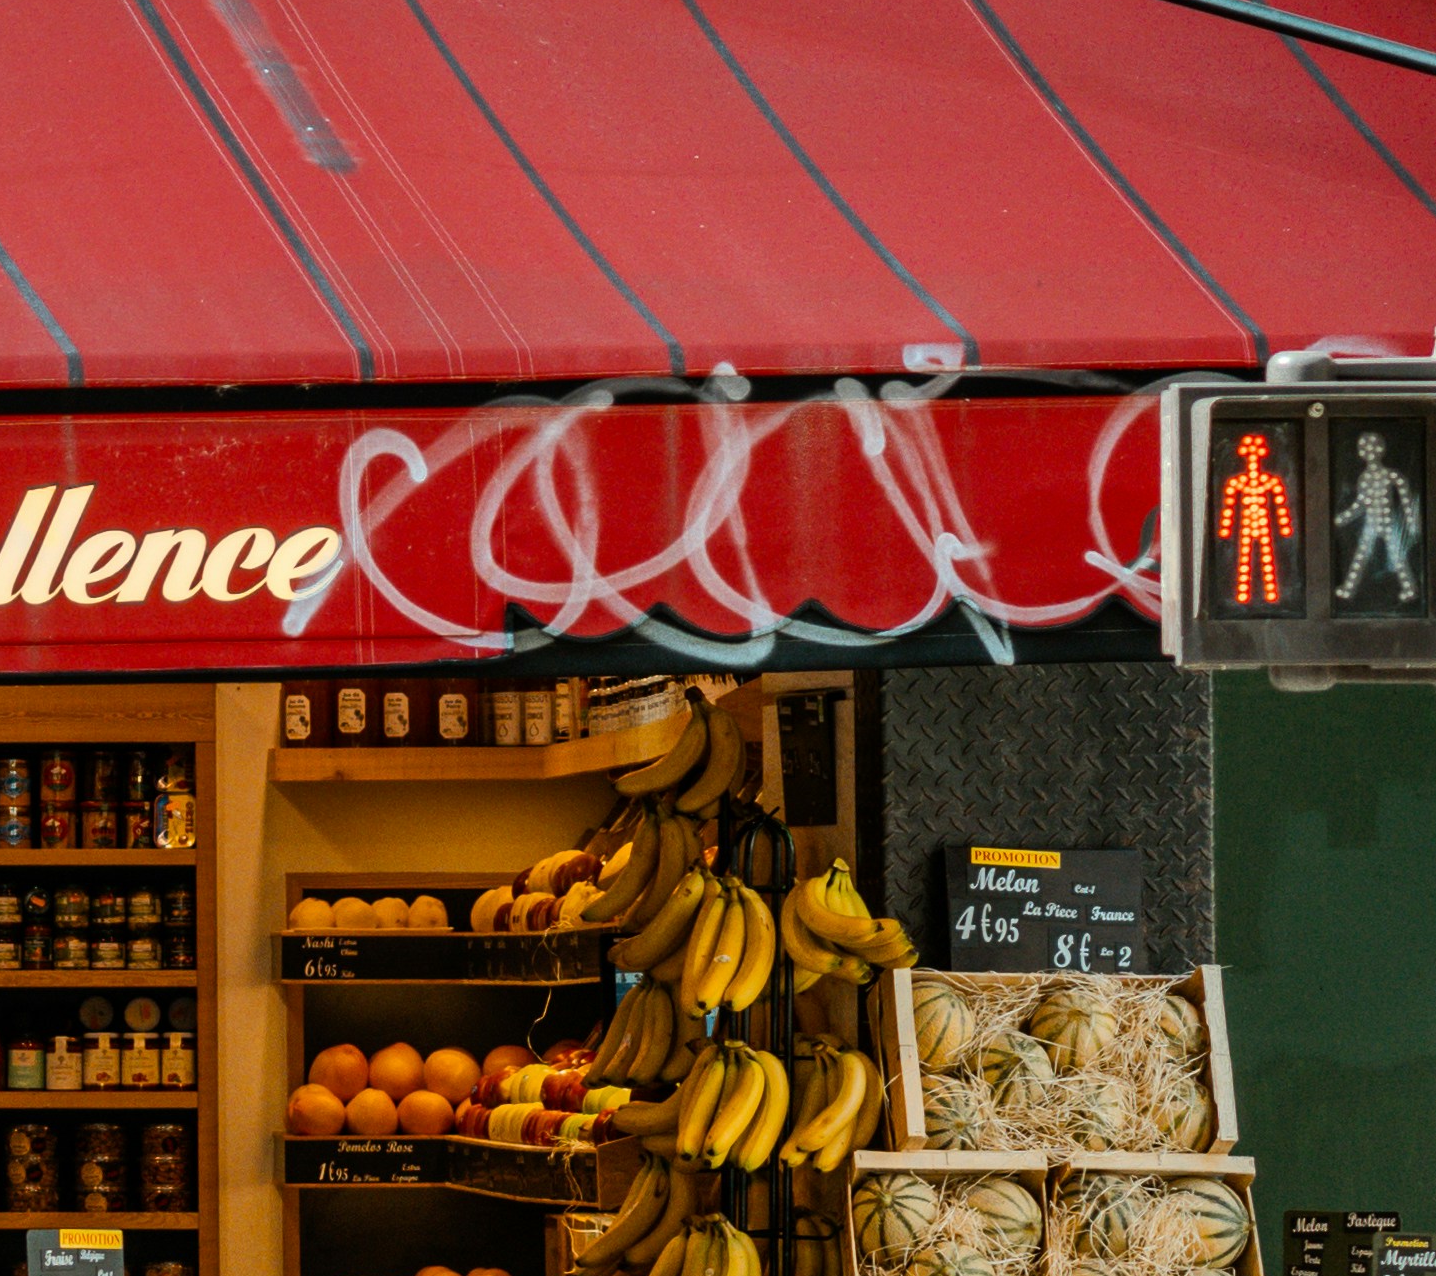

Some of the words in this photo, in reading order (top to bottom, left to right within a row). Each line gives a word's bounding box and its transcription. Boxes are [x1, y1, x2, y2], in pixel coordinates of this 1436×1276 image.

[974, 850, 1058, 865] PROMOTION
[970, 867, 1040, 893] Melon
[1023, 901, 1041, 915] La
[1045, 902, 1078, 919] Piece
[1091, 906, 1135, 922] France
[302, 936, 334, 949] Nashi
[1053, 932, 1091, 972] 8€
[1118, 946, 1132, 967] 2
[337, 1140, 381, 1153] Pomelos
[386, 1140, 413, 1153] Rose
[1292, 1217, 1328, 1232] Melon
[1347, 1212, 1396, 1231] Pastèque
[62, 1233, 120, 1245] PROMOTION
[1385, 1236, 1429, 1248] Promotion
[44, 1249, 74, 1266] Fraise
